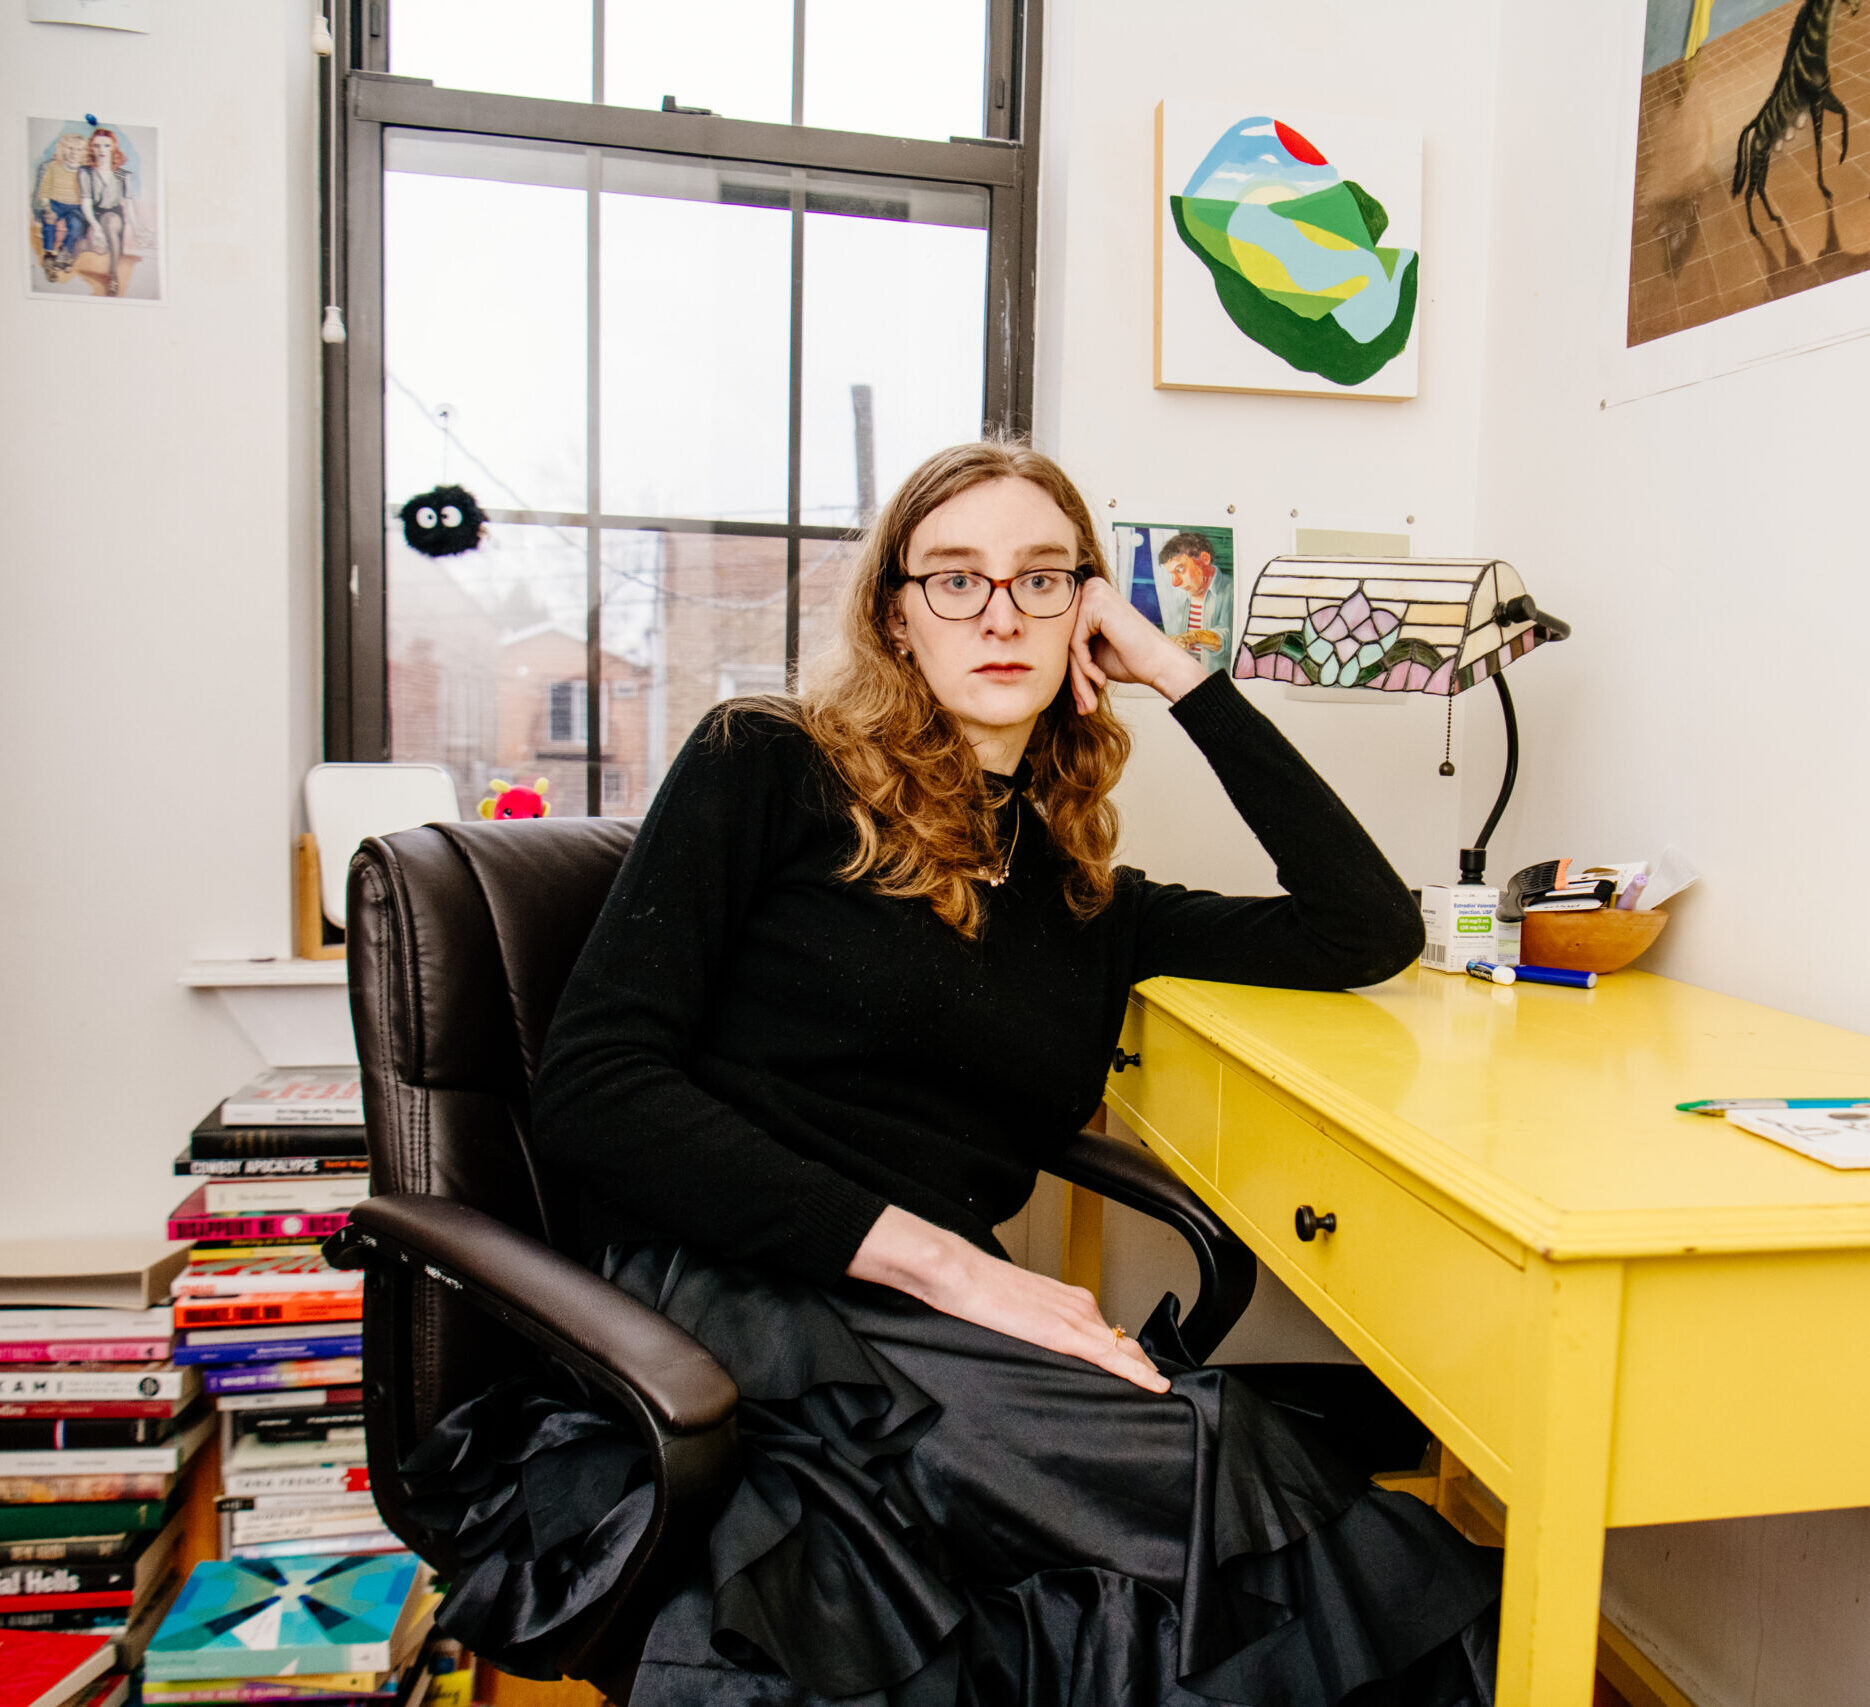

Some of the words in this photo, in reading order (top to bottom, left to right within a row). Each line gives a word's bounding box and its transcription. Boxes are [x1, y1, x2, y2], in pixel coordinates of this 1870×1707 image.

[191, 1160, 242, 1175] COWBOY
[244, 1158, 319, 1174] APOCALYPSE
[25, 1568, 80, 1594] Hells
